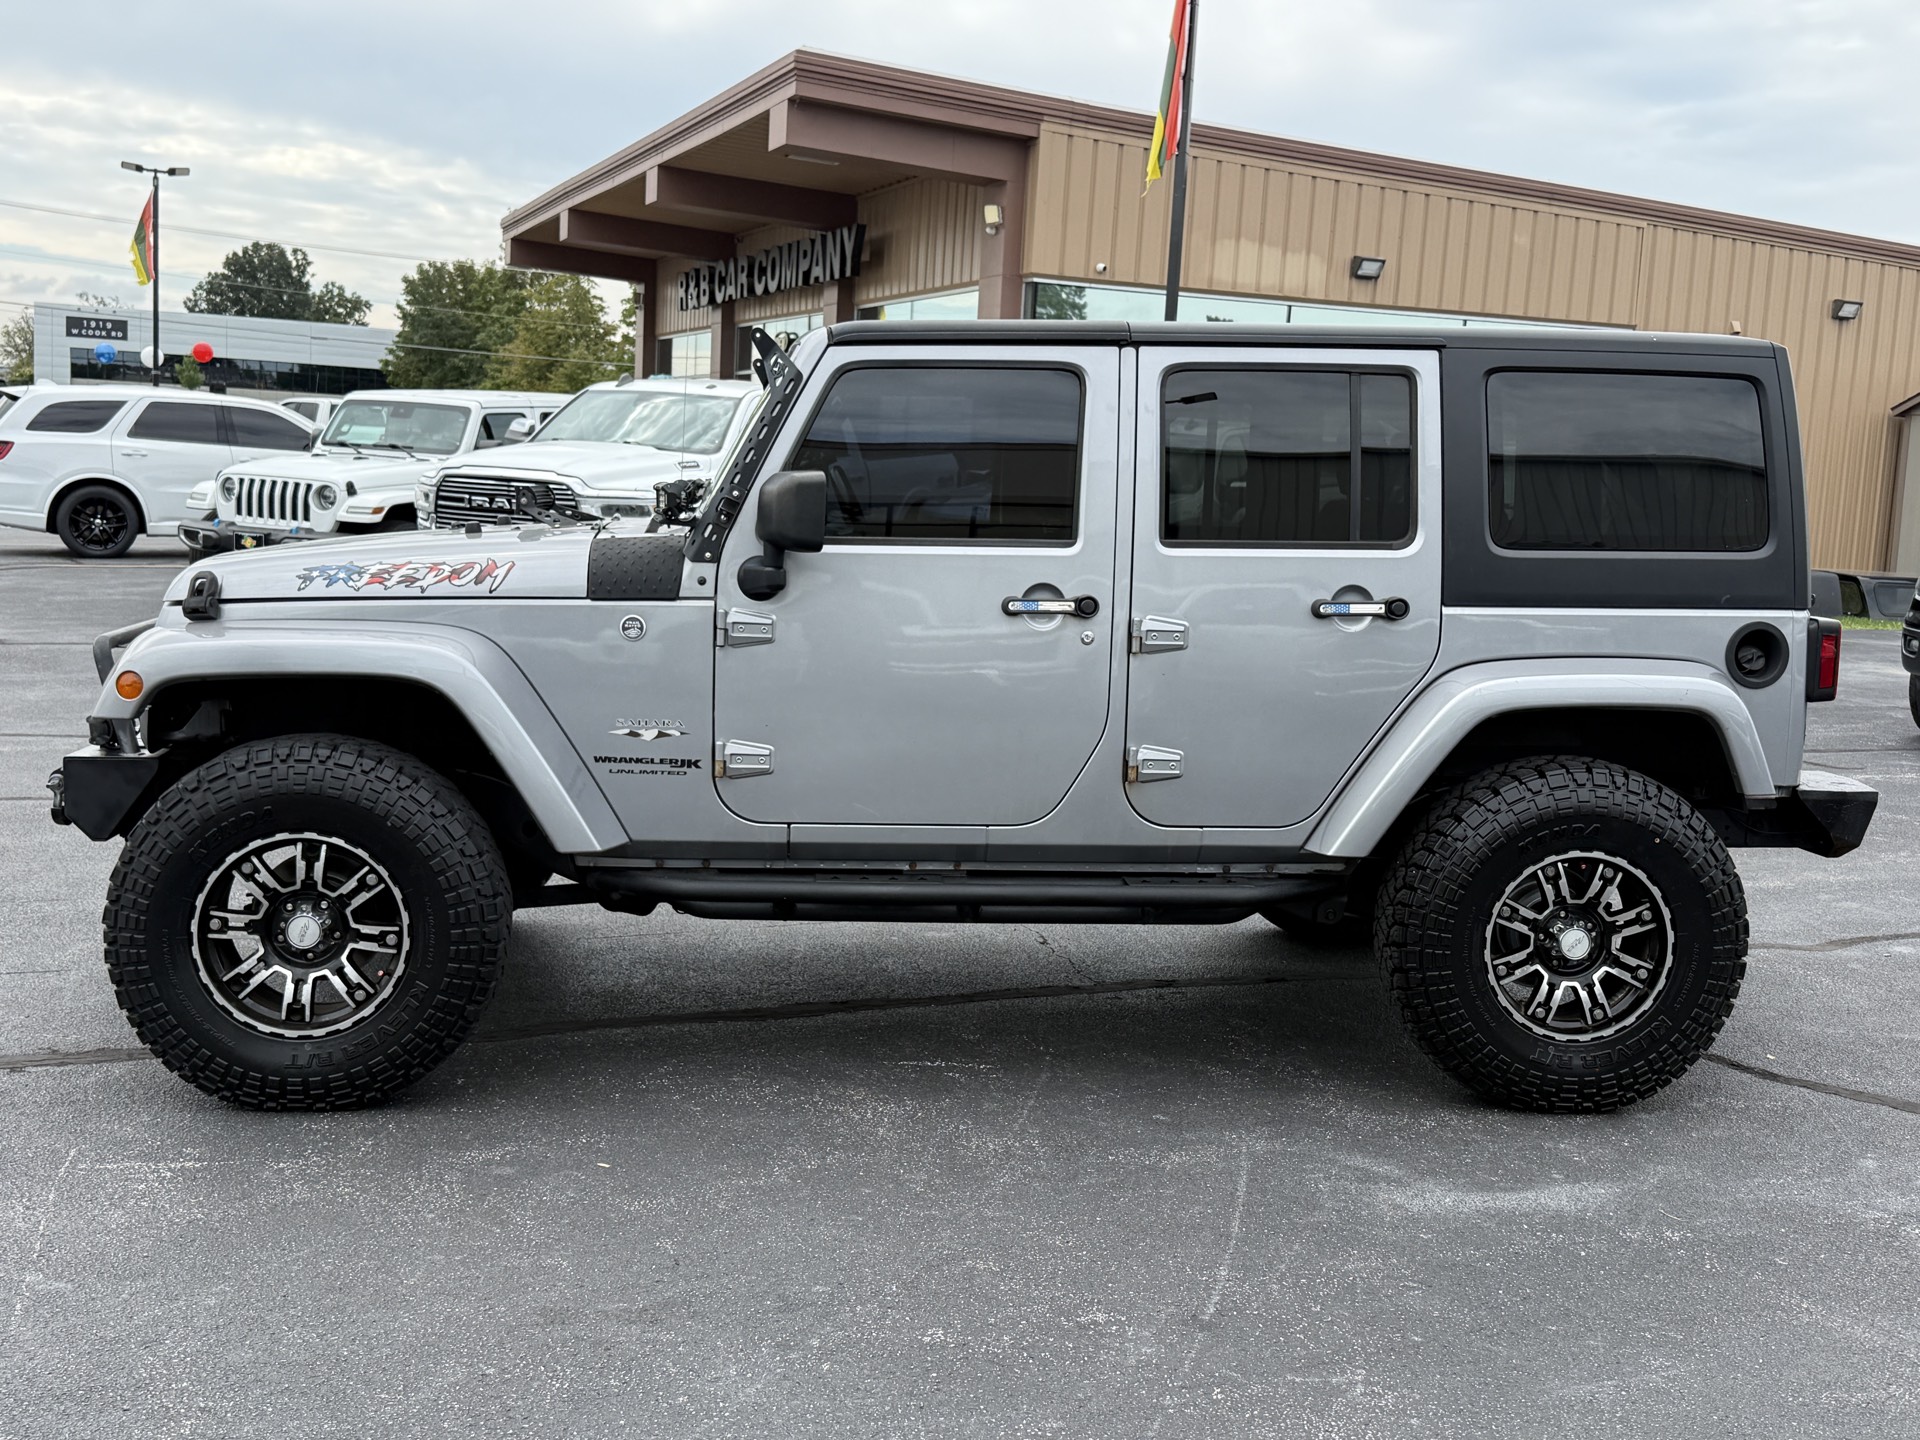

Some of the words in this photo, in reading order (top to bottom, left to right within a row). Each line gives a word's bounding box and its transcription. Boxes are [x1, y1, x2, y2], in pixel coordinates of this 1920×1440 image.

[677, 271, 710, 312] R&B
[714, 257, 749, 305] CAR
[753, 223, 860, 297] COMPANY
[82, 320, 112, 329] 1919
[470, 495, 517, 510] RA
[295, 557, 516, 594] FREEDOM
[615, 718, 686, 729] SAHARA
[593, 755, 680, 766] WRANGLER
[669, 758, 702, 769] JK
[608, 768, 688, 776] UNLIMITED
